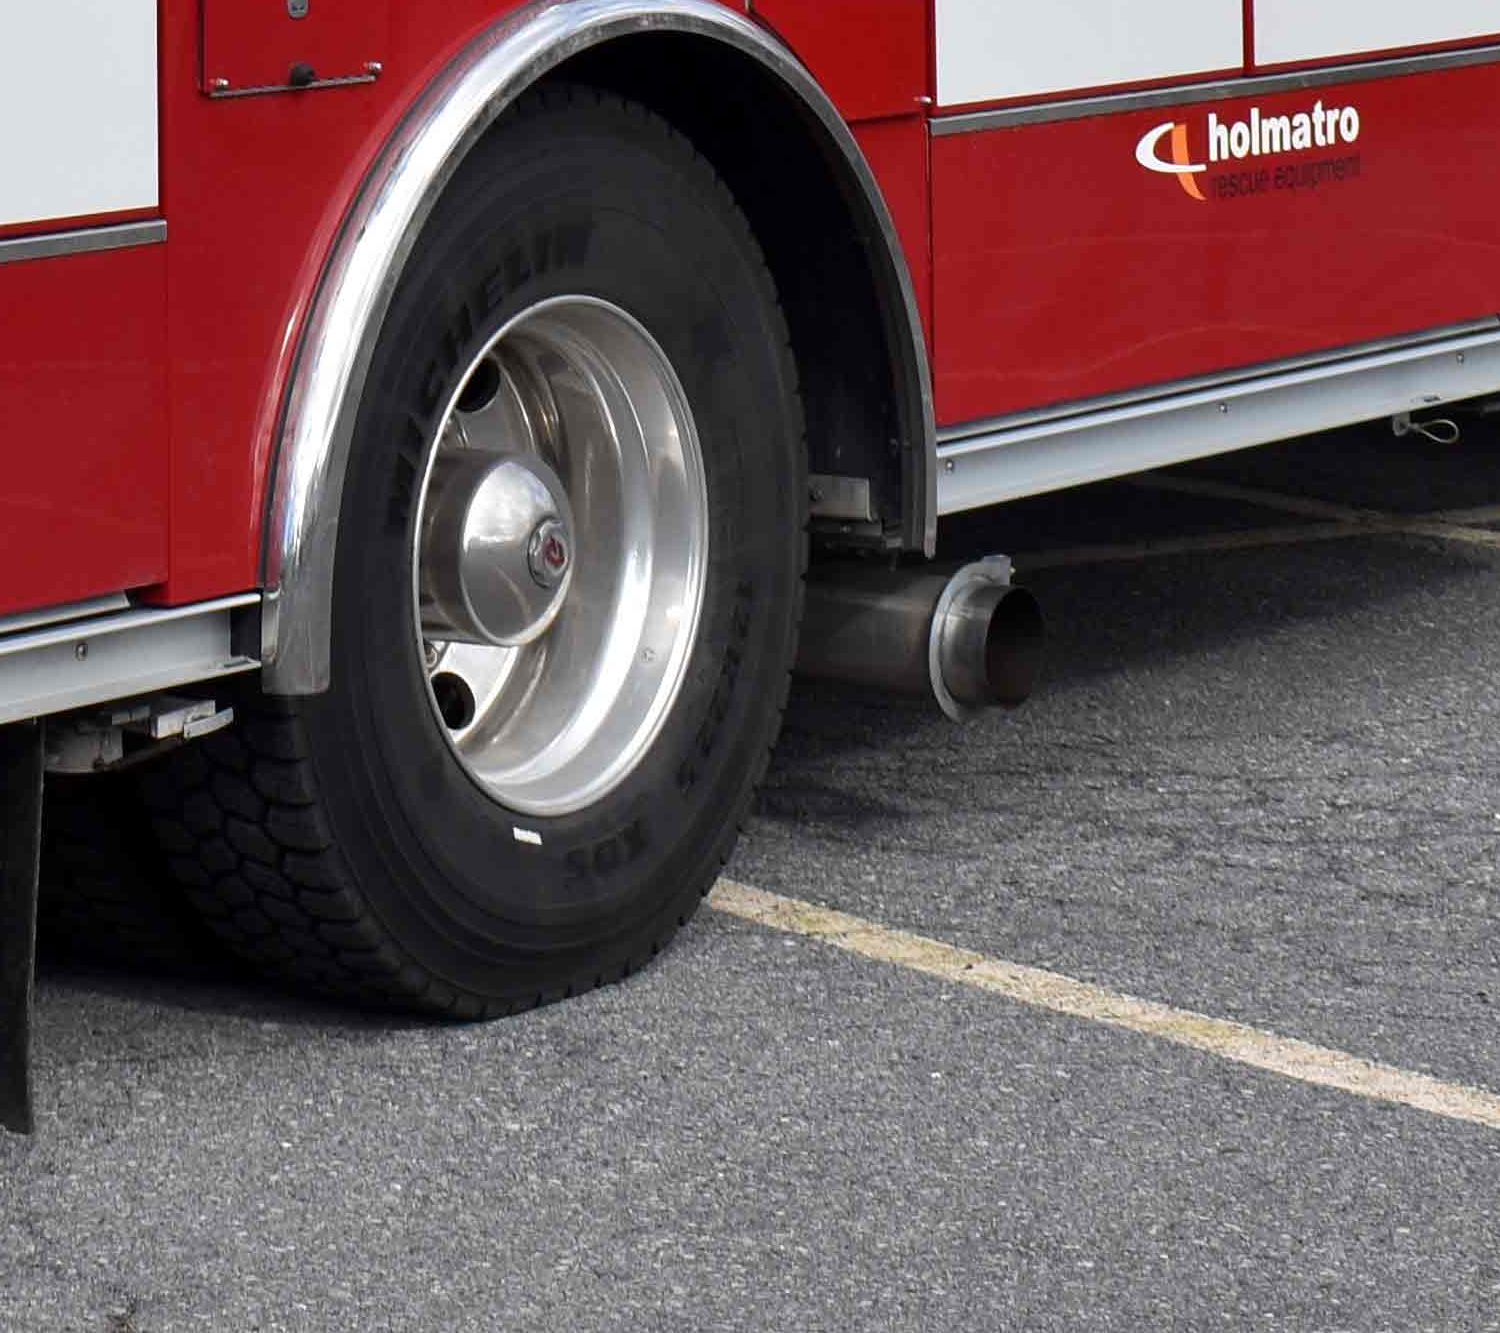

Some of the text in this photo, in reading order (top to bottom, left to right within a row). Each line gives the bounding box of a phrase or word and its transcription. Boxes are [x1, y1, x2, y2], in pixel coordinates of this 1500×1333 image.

[1207, 100, 1360, 162] holmatro
[1209, 168, 1271, 199] rescue
[384, 220, 598, 537] MICHELIN
